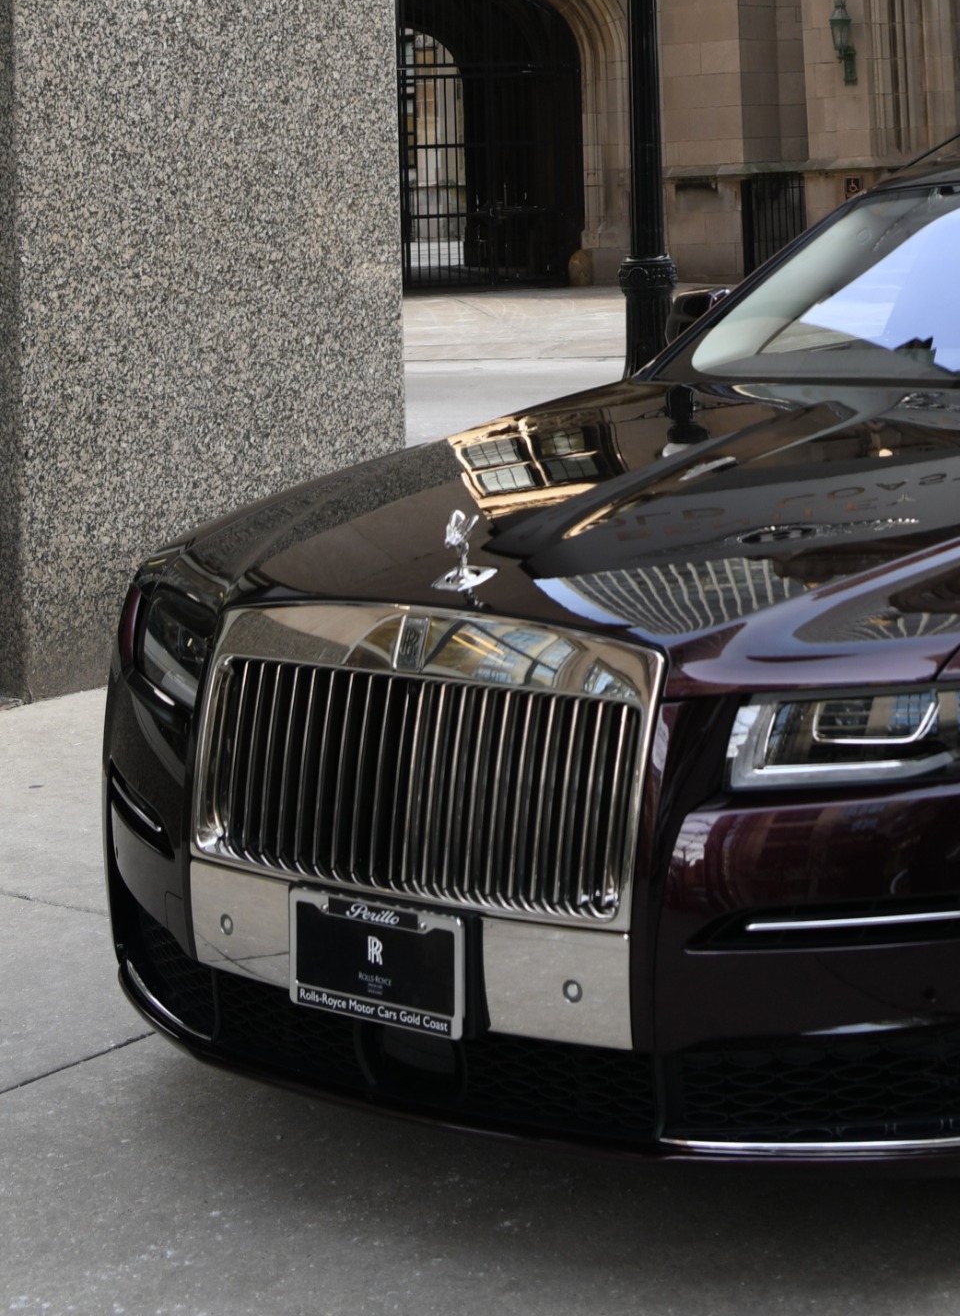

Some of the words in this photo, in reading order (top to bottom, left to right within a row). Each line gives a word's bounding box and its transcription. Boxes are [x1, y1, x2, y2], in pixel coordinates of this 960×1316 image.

[345, 902, 400, 926] Perillo
[367, 935, 384, 966] RR
[358, 971, 392, 987] ROLLS-ROYCE
[299, 988, 347, 1010] Rolls-Royce
[348, 1000, 376, 1016] Motor
[377, 1005, 397, 1021] Cars
[399, 1010, 421, 1026] Gold
[422, 1016, 448, 1032] Coast
